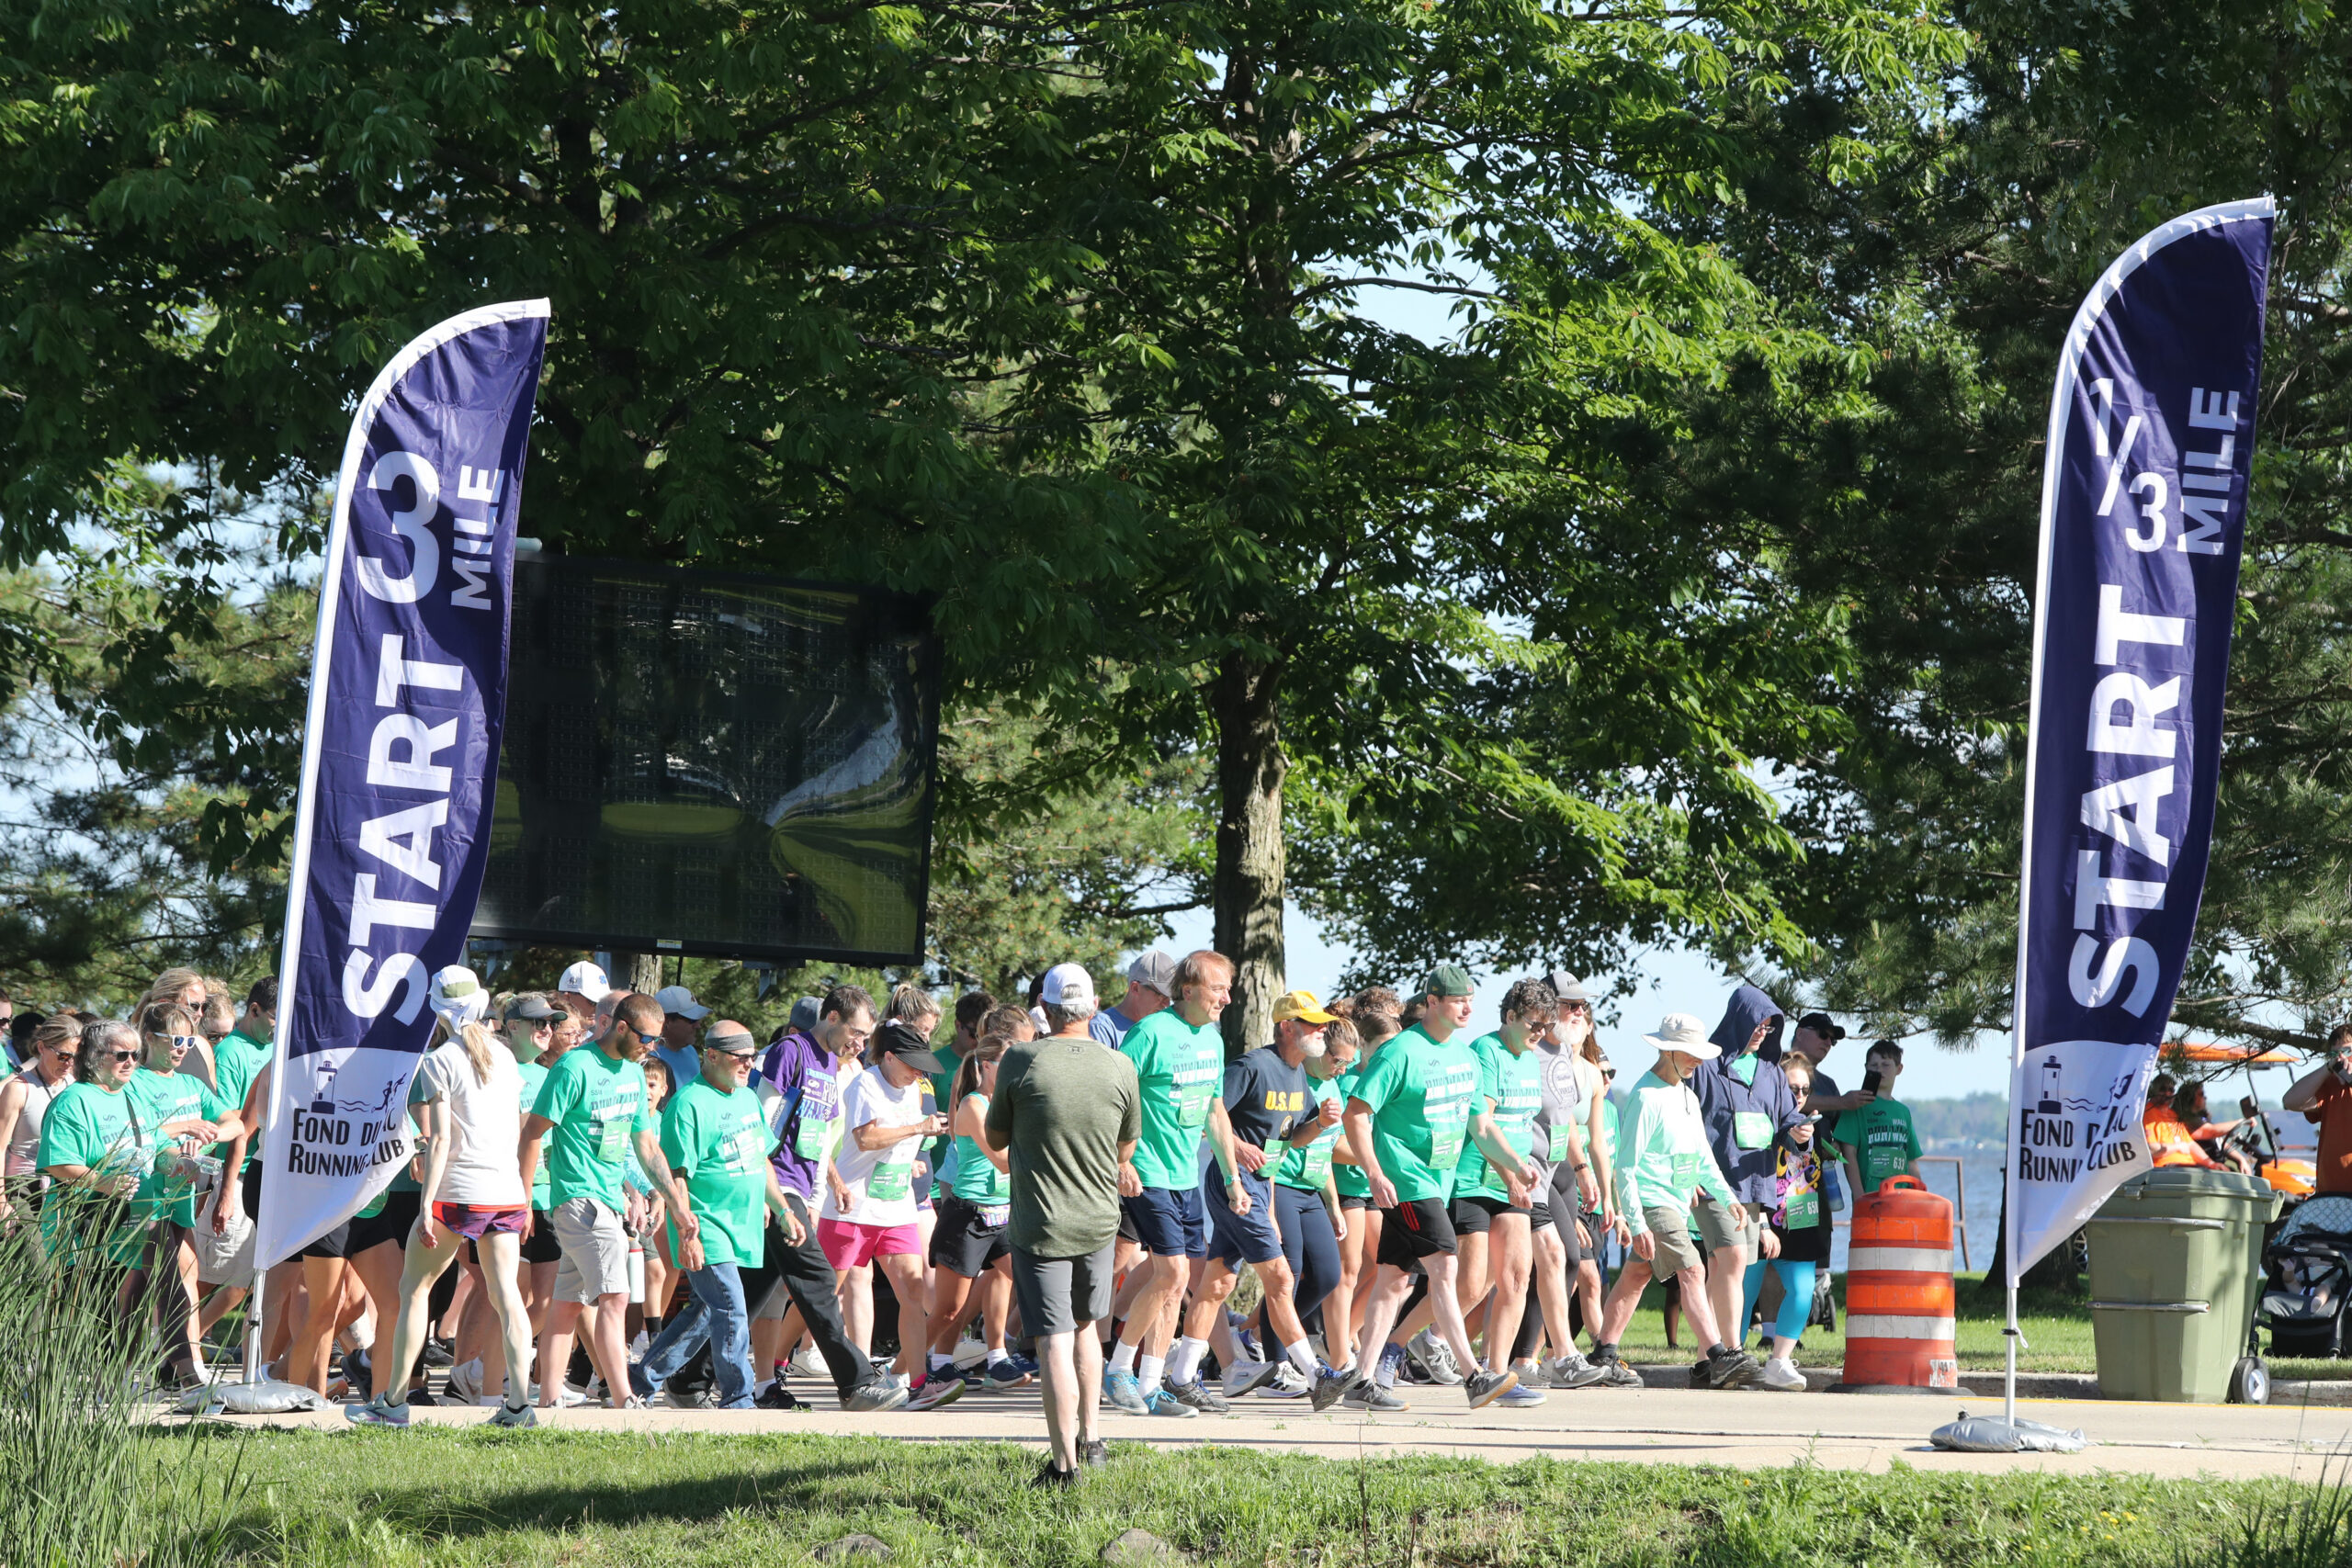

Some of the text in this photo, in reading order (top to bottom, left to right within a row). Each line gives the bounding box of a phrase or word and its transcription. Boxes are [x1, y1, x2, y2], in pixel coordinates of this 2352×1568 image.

[356, 450, 440, 604] 3
[450, 464, 505, 611] MILE
[2177, 387, 2240, 555] MILE
[342, 633, 464, 1027] START
[2068, 583, 2186, 1019] START
[292, 1108, 350, 1145] FOND
[1265, 1090, 1288, 1111] U.S.
[2020, 1108, 2074, 1148] FOND
[2086, 1141, 2136, 1171] CLUB
